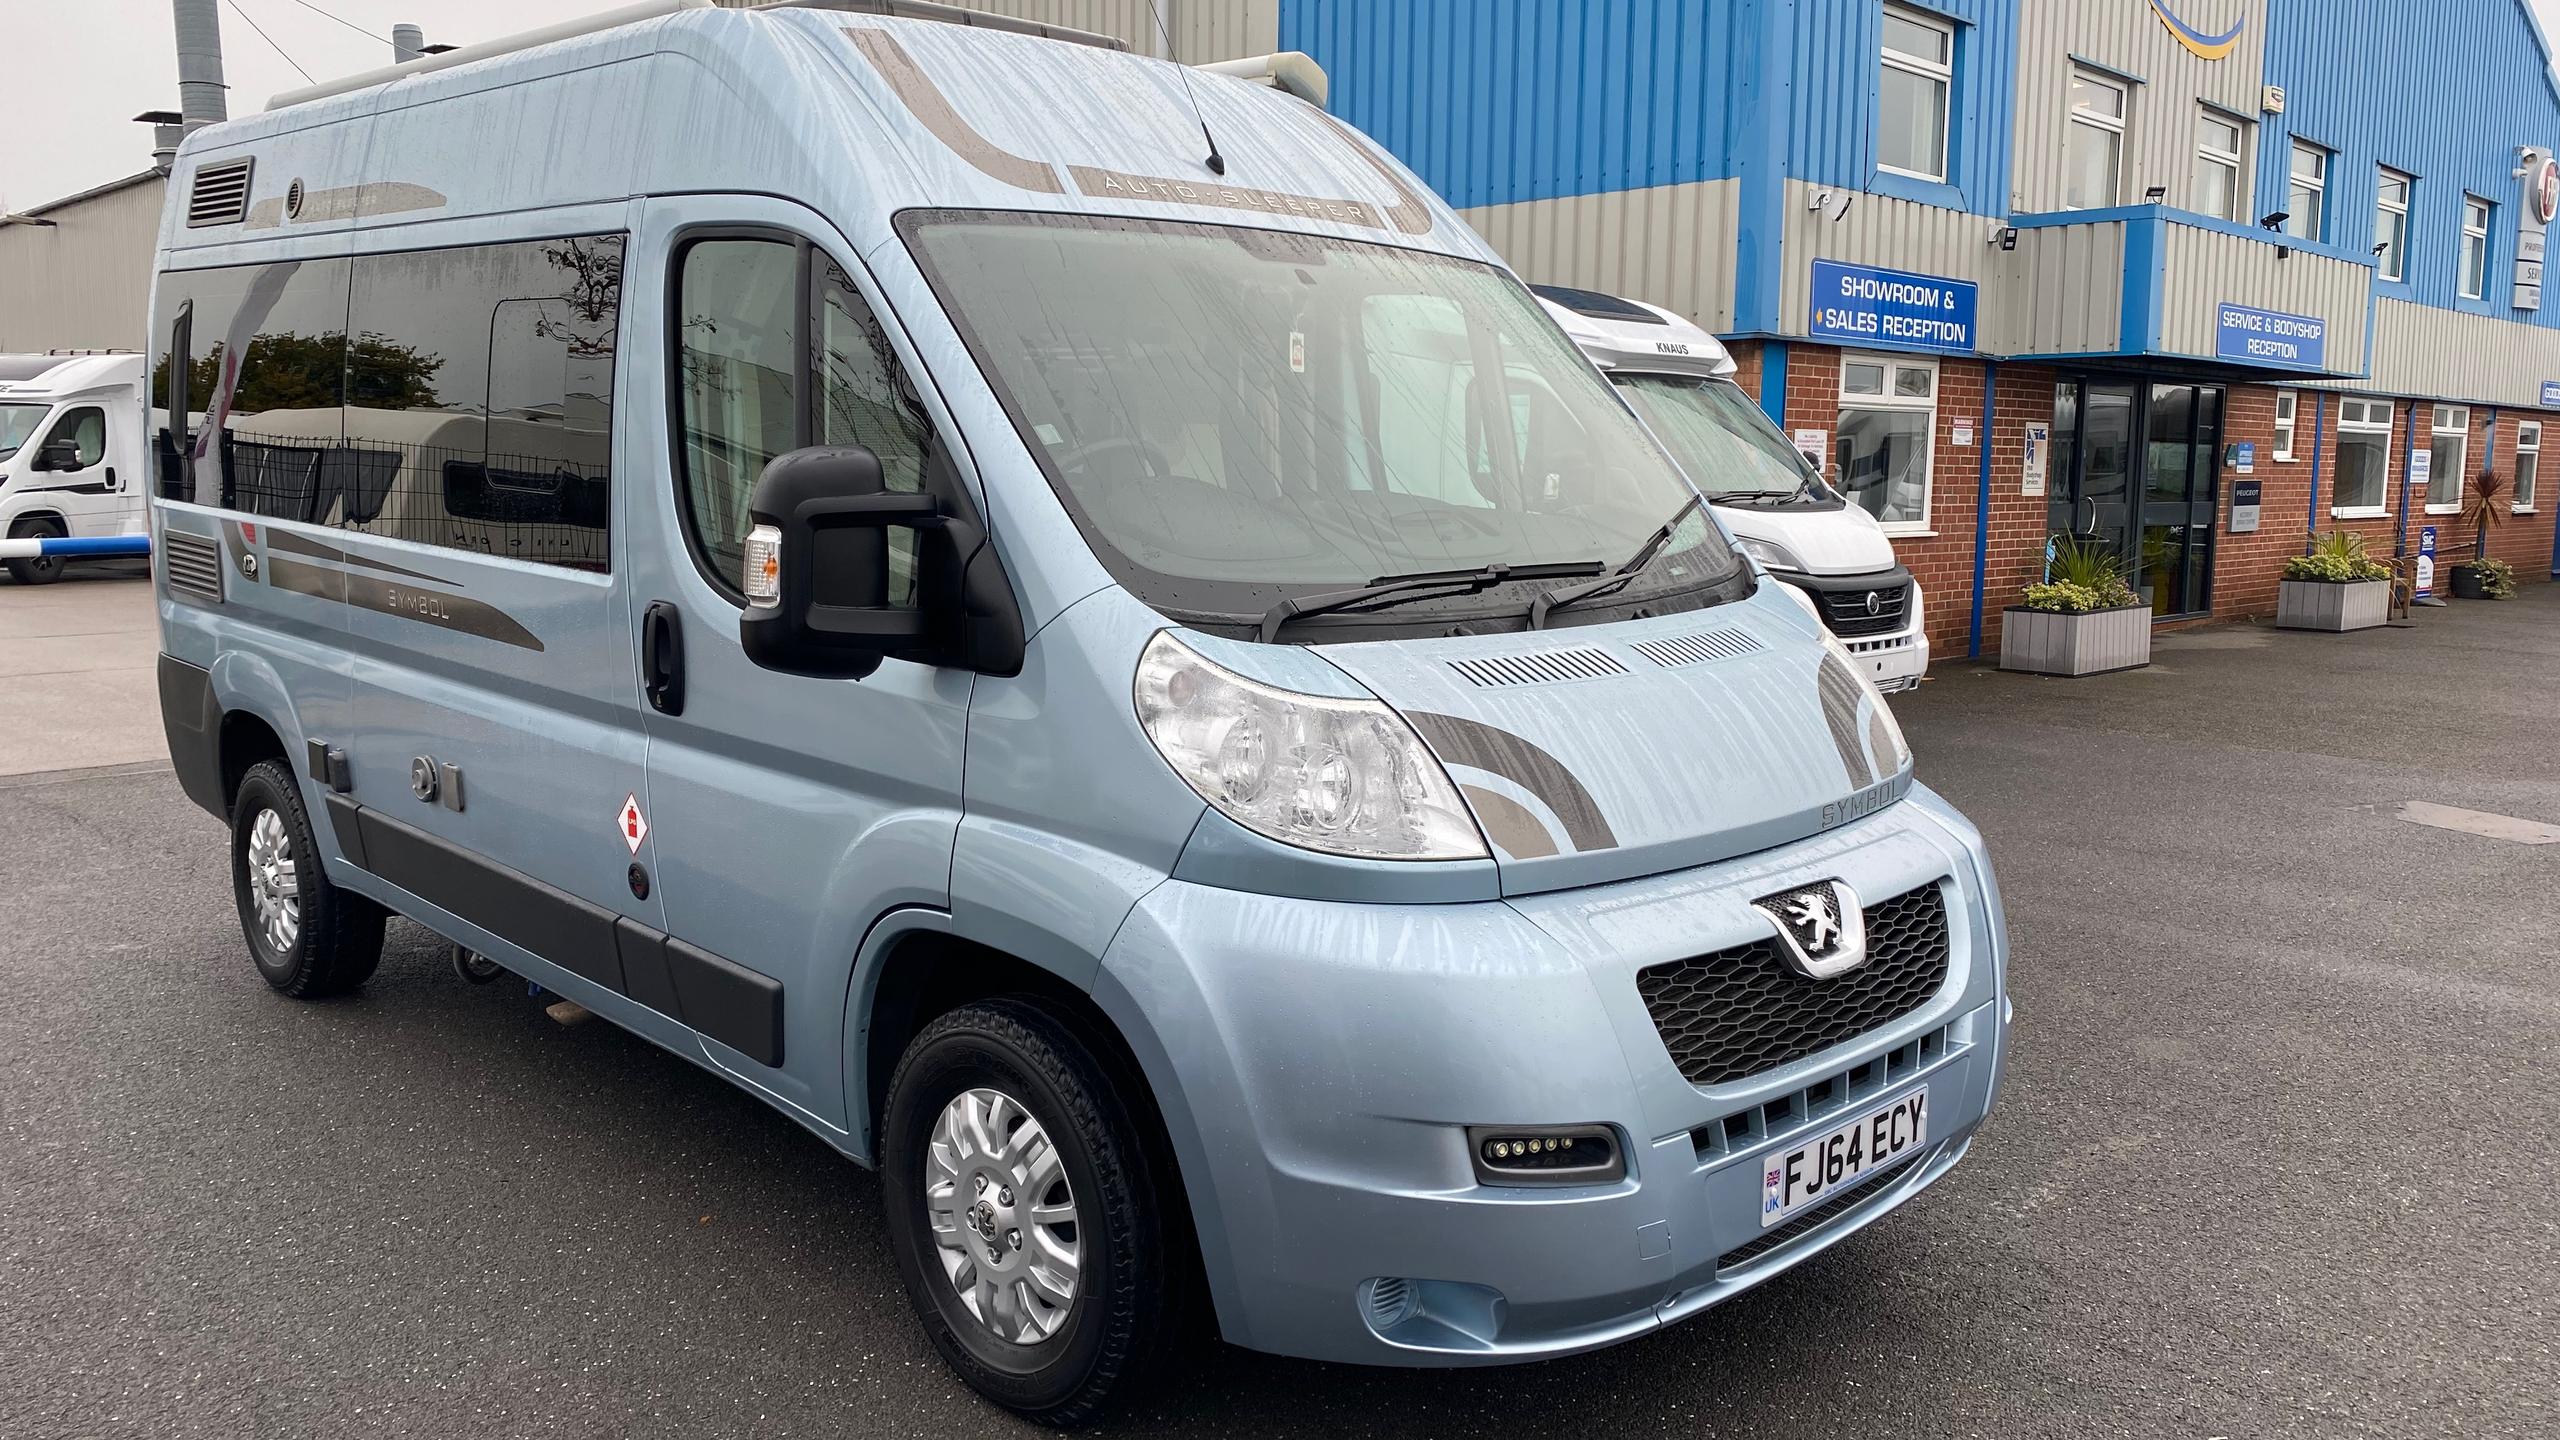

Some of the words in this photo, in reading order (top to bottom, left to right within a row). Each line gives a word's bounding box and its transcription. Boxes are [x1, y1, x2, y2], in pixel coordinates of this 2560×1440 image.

[1841, 276, 1939, 308] SHOWROOM
[1943, 290, 1955, 310] &
[1826, 308, 1878, 333] SALES
[1883, 315, 1966, 343] RECEPTION
[2223, 311, 2262, 332] SERVICE
[2265, 318, 2272, 333] &
[2274, 319, 2322, 340] BODYSHOP
[1656, 342, 1689, 355] KNAUS
[2247, 338, 2298, 359] RECEPTION
[2236, 489, 2259, 497] PEUGEOT
[389, 589, 450, 620] SYMBOL
[1821, 780, 1900, 829] SYMBOL
[1783, 1124, 1863, 1207] FJ64
[1871, 1094, 1925, 1165] ECY
[1764, 1197, 1780, 1214] UK
